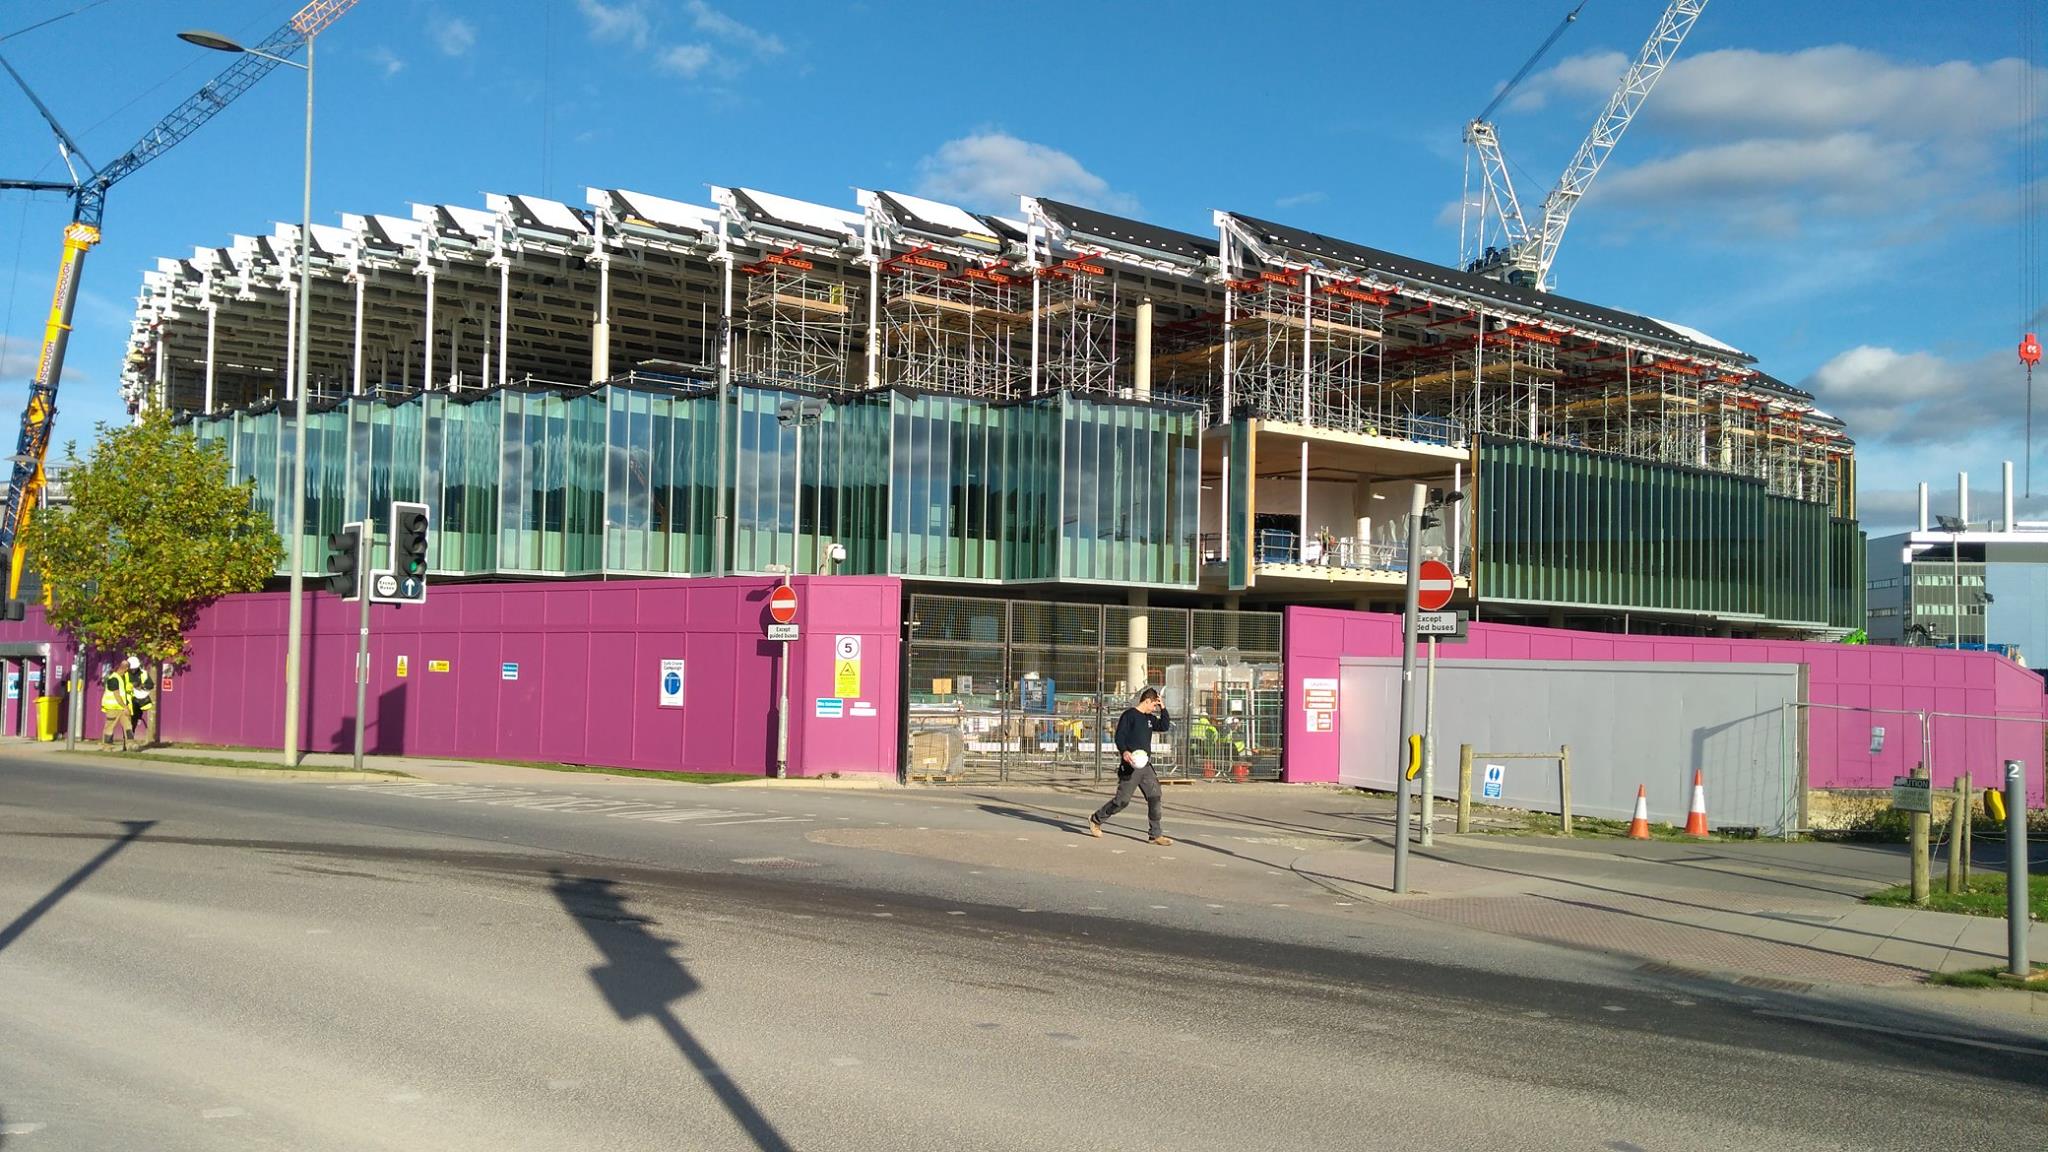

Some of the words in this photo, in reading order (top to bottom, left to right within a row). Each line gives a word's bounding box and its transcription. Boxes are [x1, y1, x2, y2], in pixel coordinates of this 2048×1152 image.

[55, 261, 71, 310] AINSCOUGH
[37, 341, 55, 385] NSCOUGH
[845, 643, 852, 653] 5
[2008, 763, 2020, 777] 2
